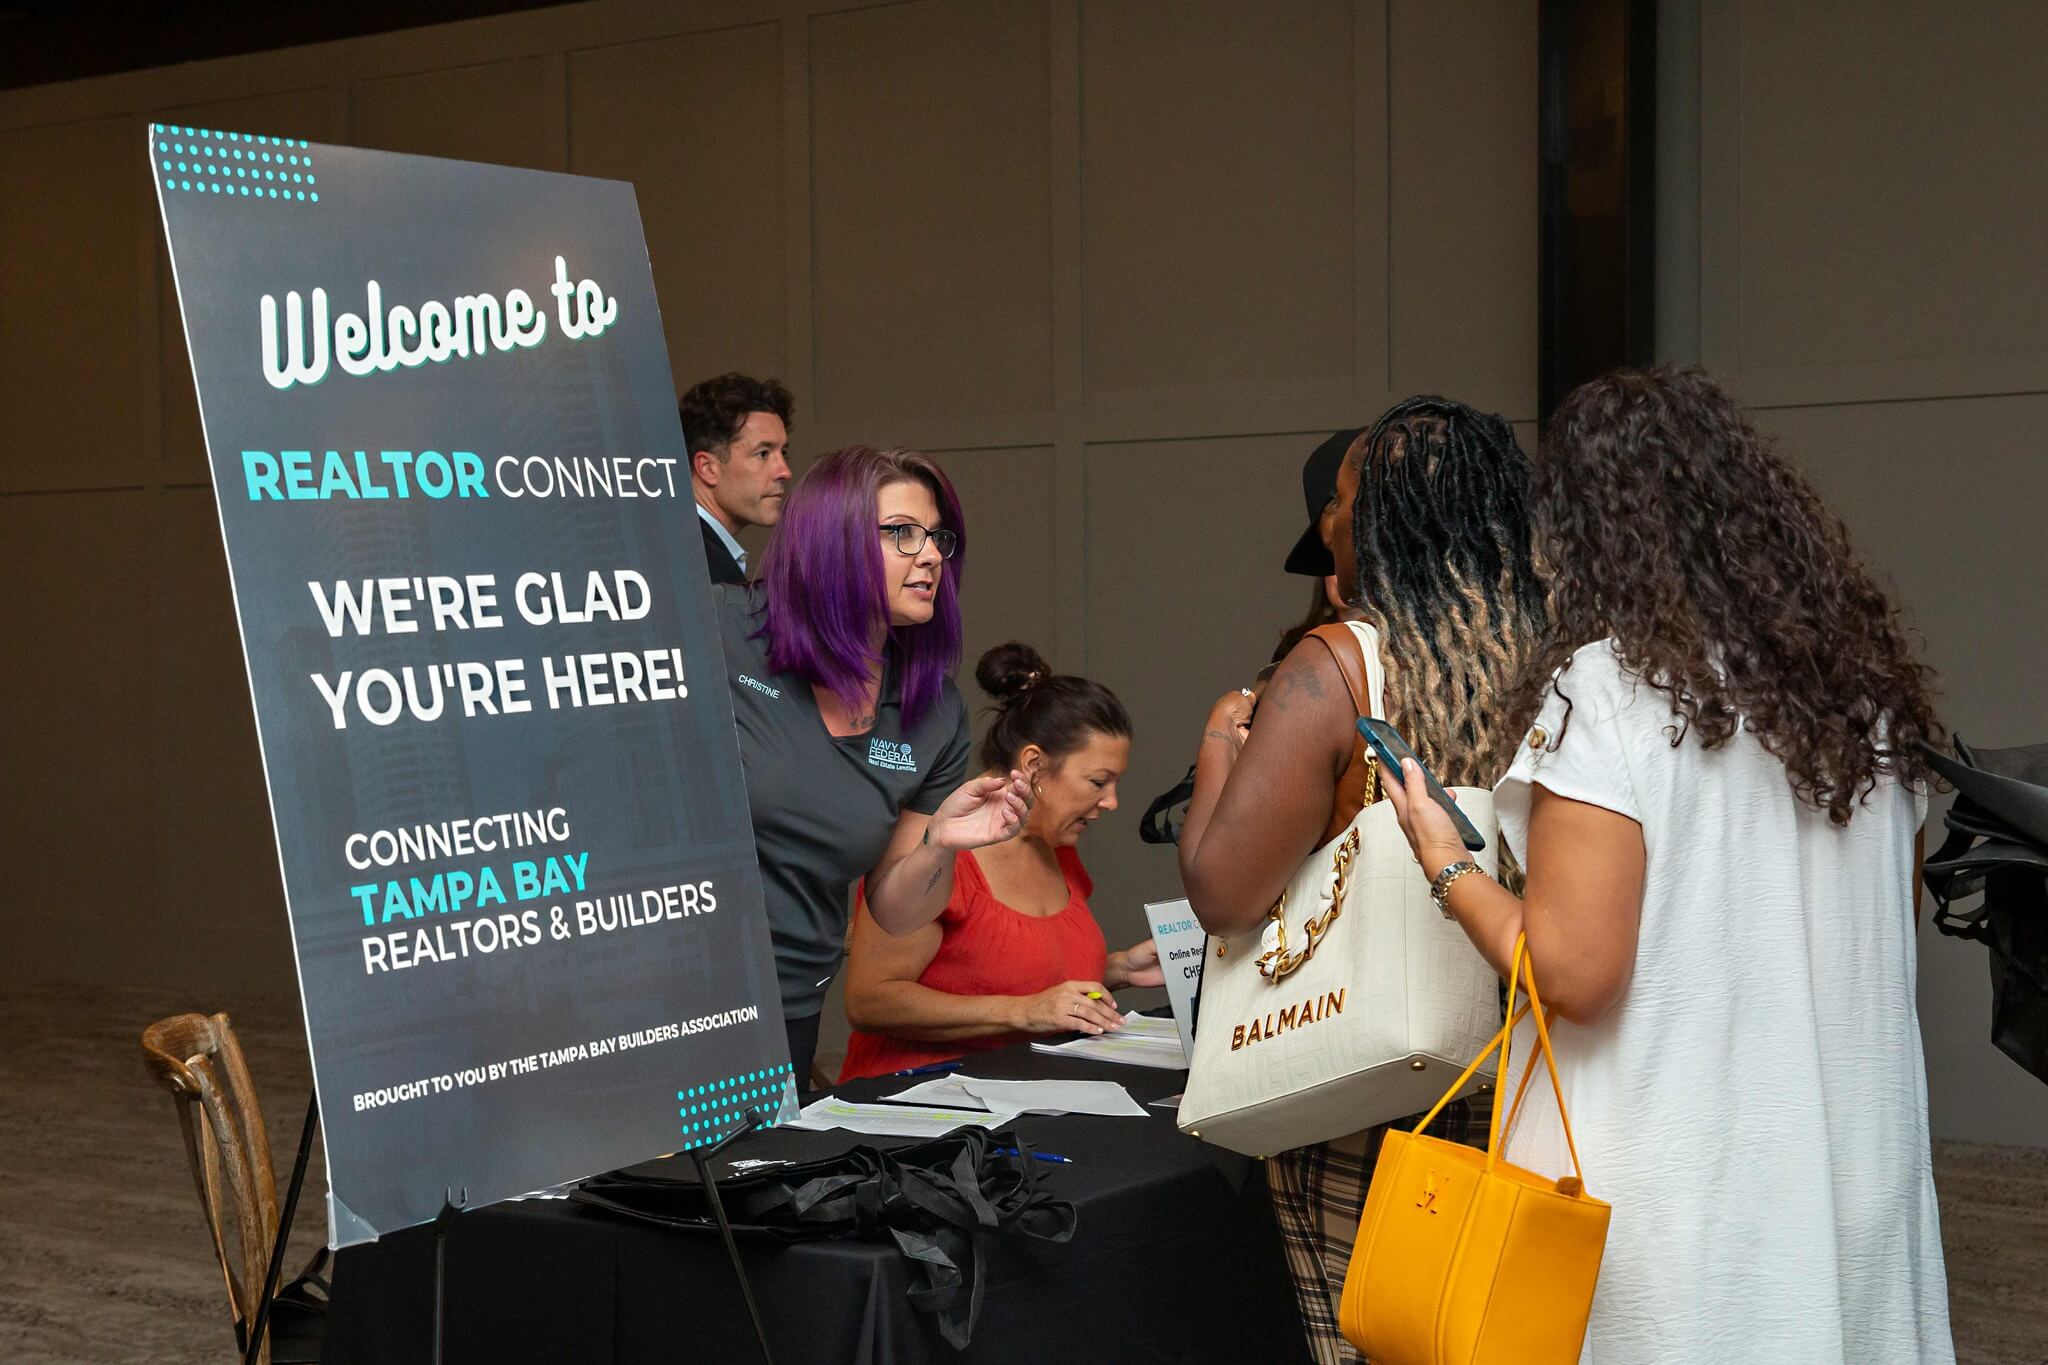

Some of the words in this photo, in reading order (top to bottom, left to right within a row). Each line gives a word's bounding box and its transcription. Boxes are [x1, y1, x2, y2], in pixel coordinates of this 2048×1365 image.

[260, 279, 546, 391] Welcome
[551, 255, 617, 340] to
[241, 450, 489, 501] REALTOR
[495, 455, 677, 498] CONNECT
[308, 573, 503, 637] WE'RE
[515, 569, 651, 625] GLAD
[310, 658, 532, 729] YOU'RE
[542, 648, 688, 709] HERE!
[738, 674, 781, 699] CHRISTINE
[869, 746, 916, 764] FEDERAL
[870, 737, 899, 752] NAVY
[344, 807, 570, 870] CONNECTING
[351, 866, 507, 925] TAMPA
[513, 852, 589, 901] BAY
[362, 909, 542, 974] REALTORS
[550, 905, 571, 940] &
[576, 880, 717, 935] BUILDERS
[1157, 920, 1193, 935] REALTOR
[1169, 949, 1191, 961] Online
[1231, 988, 1345, 1050] BALMAIN
[353, 1079, 430, 1112] BROUGHT
[430, 1074, 453, 1093] TO
[453, 1066, 487, 1088] YOU
[488, 1061, 508, 1081] BY
[509, 1054, 539, 1075] THE
[538, 1044, 589, 1068] TAMPA
[589, 1037, 616, 1057] BAY
[617, 1023, 680, 1051] BUILDERS
[680, 1005, 759, 1036] ASSOCIATION
